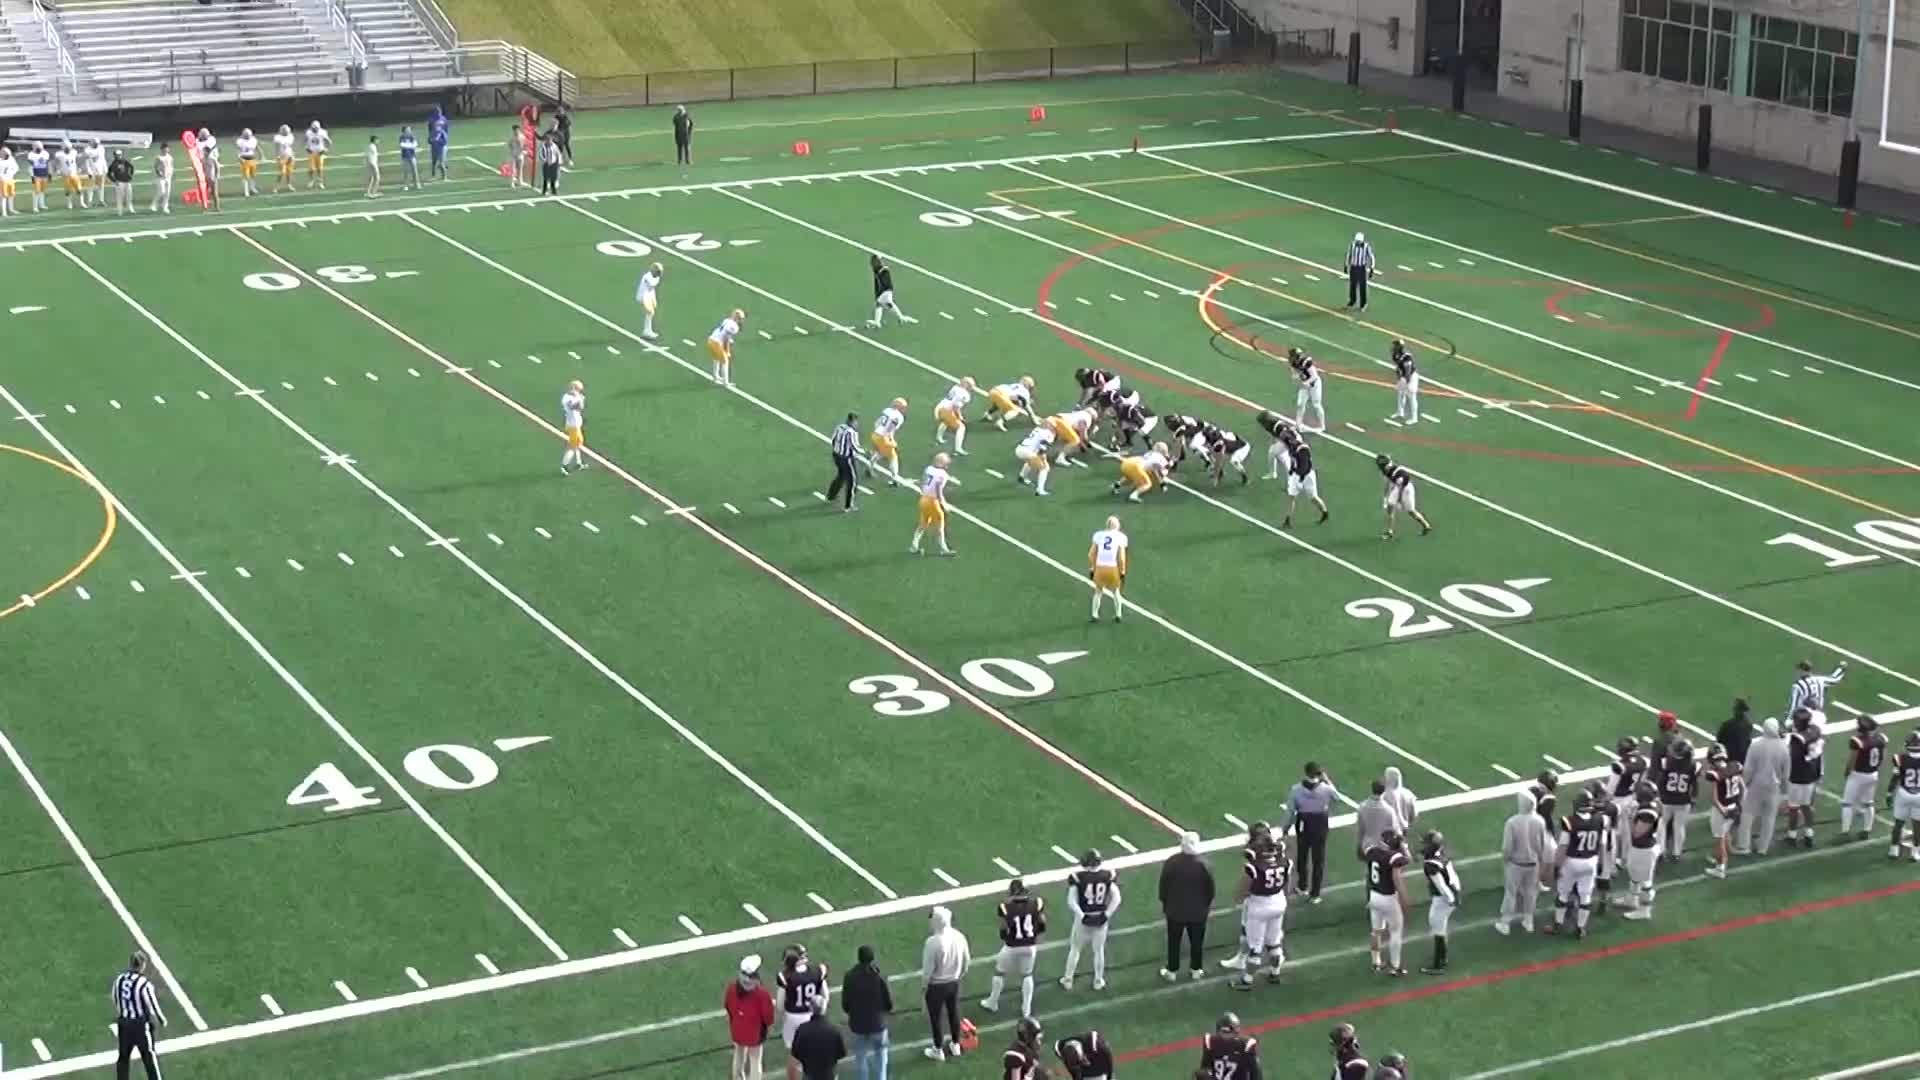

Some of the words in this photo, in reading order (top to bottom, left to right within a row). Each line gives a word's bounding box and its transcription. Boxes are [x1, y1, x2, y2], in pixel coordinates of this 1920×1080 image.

[1103, 536, 1113, 551] 2
[1344, 583, 1534, 637] 20
[848, 657, 1055, 716] 30
[286, 744, 499, 812] 40
[1666, 772, 1689, 792] 26
[1577, 830, 1598, 850] 70
[1264, 867, 1286, 889] 55
[1371, 861, 1380, 884] 6
[1084, 883, 1106, 905] 48
[1013, 913, 1034, 939] 14
[1214, 1060, 1238, 1080] 97
